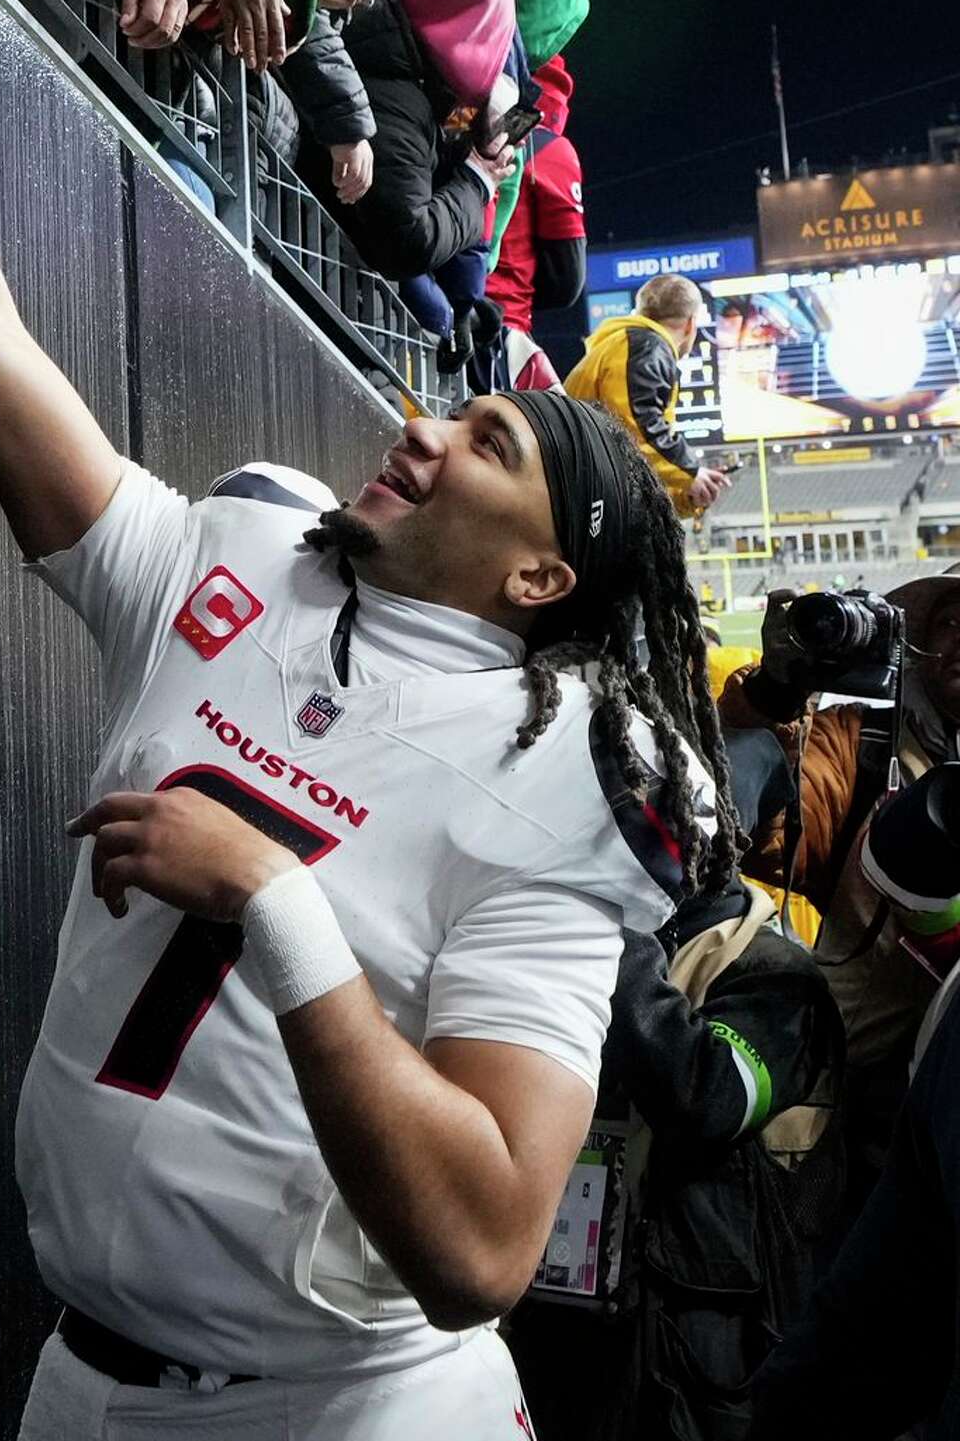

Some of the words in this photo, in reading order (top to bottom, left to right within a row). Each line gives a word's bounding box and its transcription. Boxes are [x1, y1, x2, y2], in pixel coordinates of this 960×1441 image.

[801, 208, 924, 239] ACRISURE
[824, 231, 898, 251] STADIUM
[617, 259, 659, 279] BUD
[660, 252, 720, 274] LIGHT
[190, 574, 253, 638] C
[300, 705, 327, 735] NFL
[195, 698, 369, 829] HOUSTON
[95, 763, 342, 1101] 7
